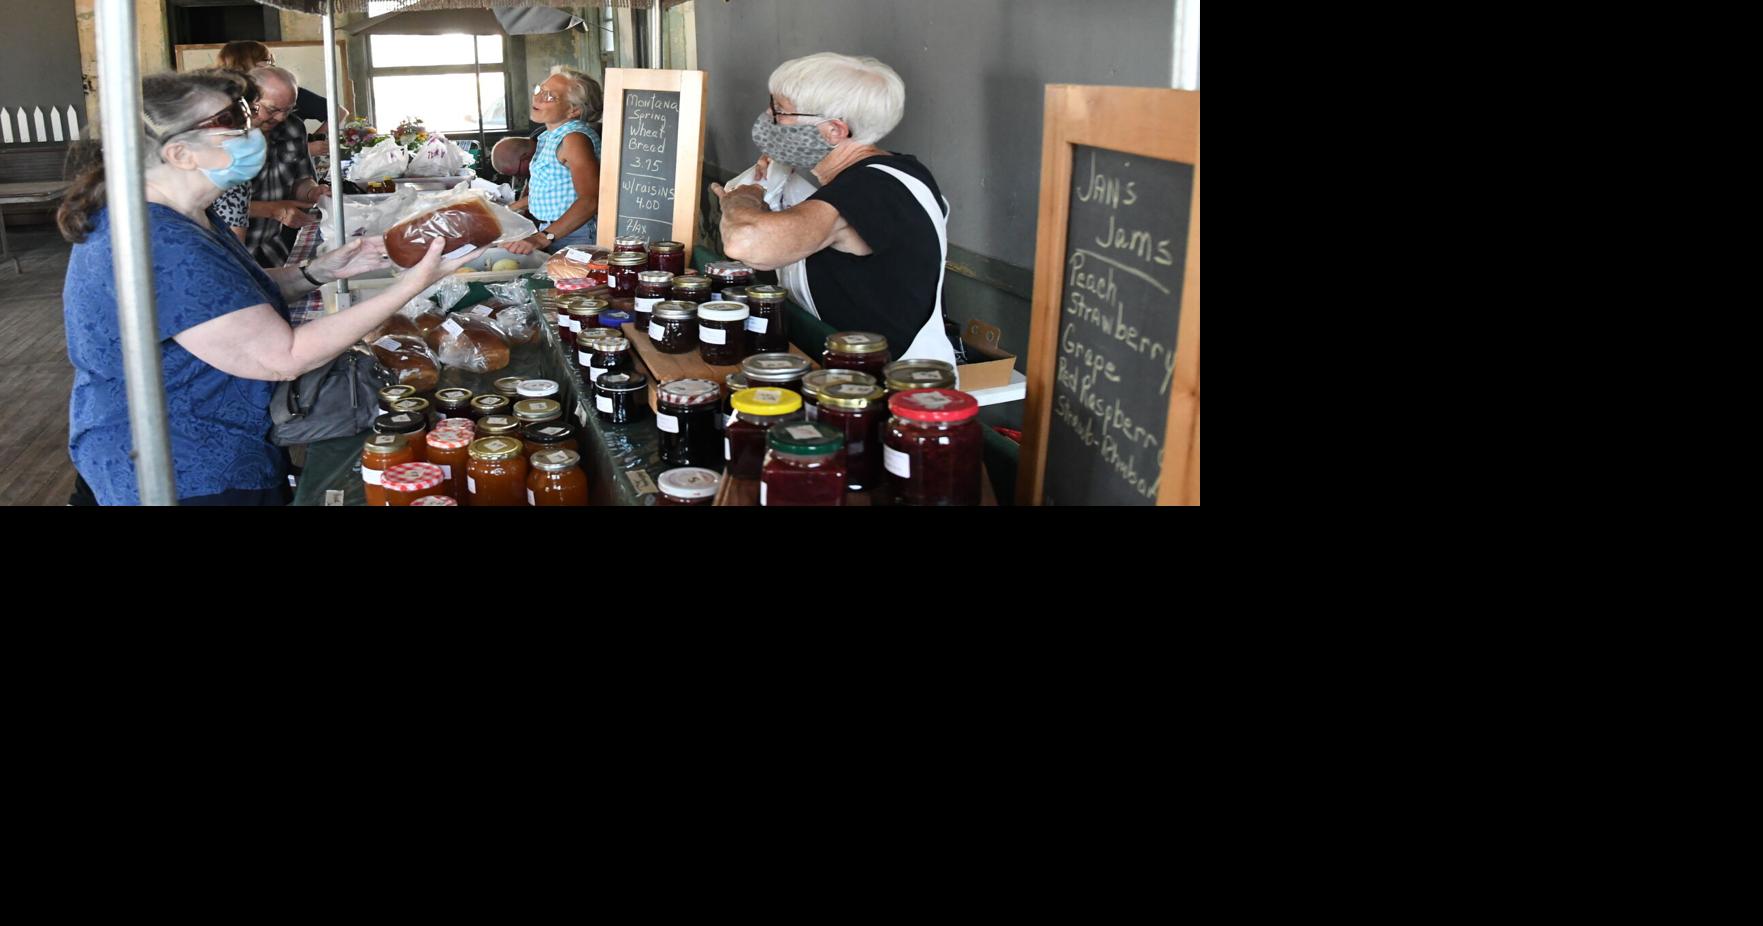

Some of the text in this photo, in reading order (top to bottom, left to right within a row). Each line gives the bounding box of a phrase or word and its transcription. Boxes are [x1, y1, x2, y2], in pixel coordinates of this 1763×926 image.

[628, 138, 666, 153] Bread
[629, 156, 663, 172] 3.75
[635, 198, 661, 210] 4.00
[1068, 252, 1118, 307] Peach
[1062, 322, 1121, 385] Grape
